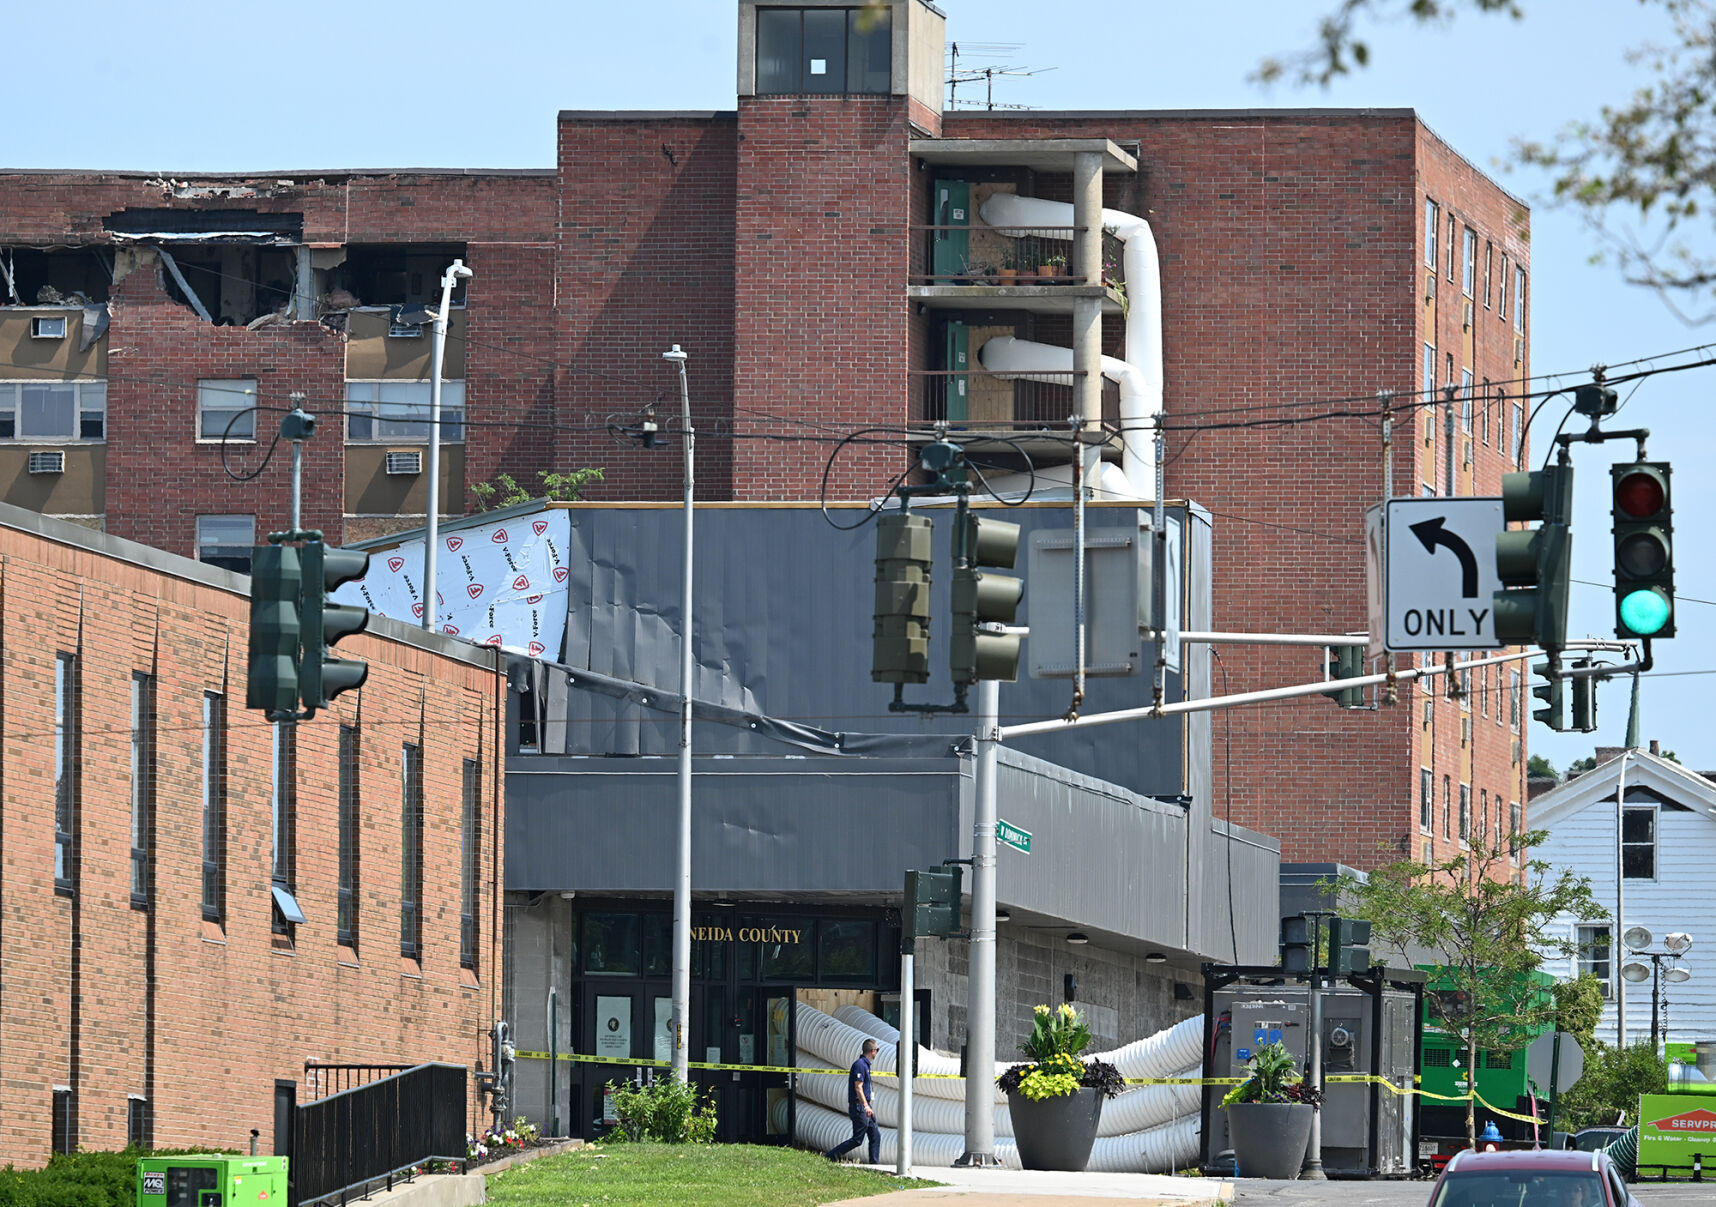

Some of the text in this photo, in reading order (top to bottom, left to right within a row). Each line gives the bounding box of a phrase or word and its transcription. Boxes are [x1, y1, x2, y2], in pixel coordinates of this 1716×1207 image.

[1404, 608, 1489, 636] ONLY
[690, 927, 800, 944] NEIDA COUNTY
[1672, 1119, 1716, 1128] SERVPR
